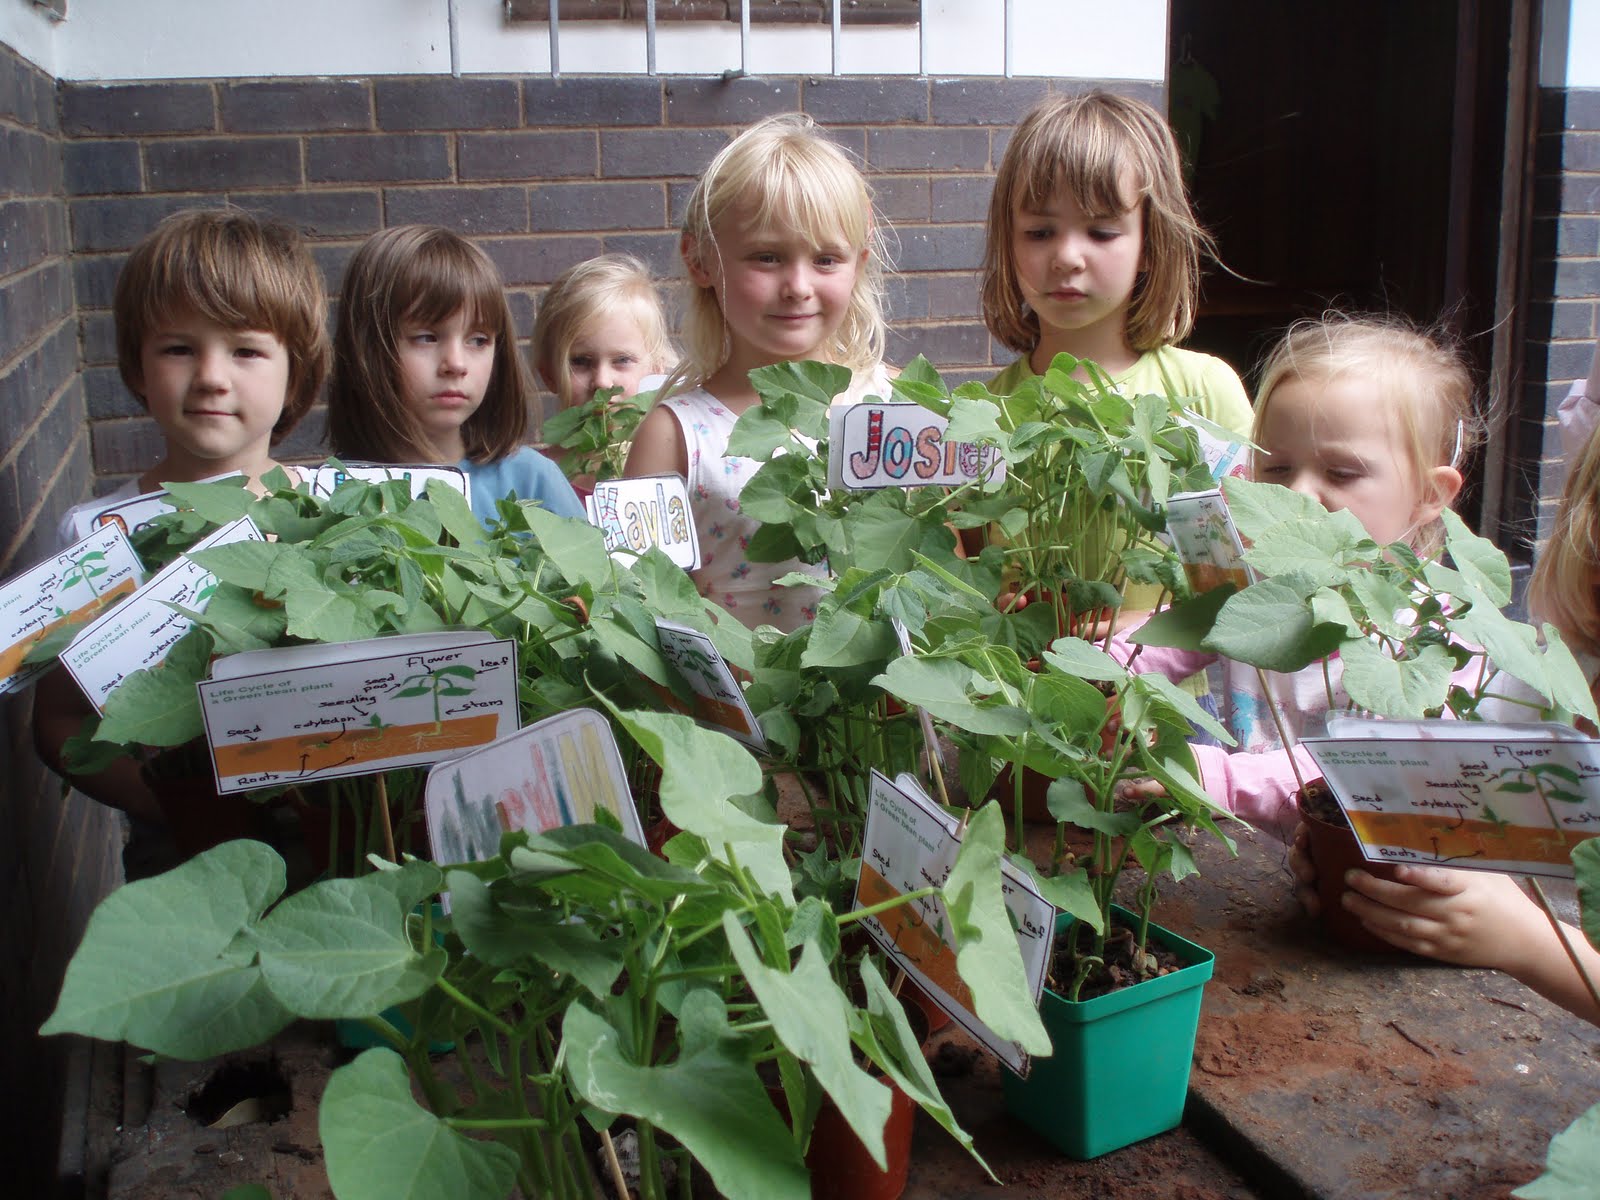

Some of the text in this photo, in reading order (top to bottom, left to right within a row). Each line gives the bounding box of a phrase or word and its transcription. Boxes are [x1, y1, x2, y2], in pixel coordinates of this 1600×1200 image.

[595, 483, 688, 551] Kayla
[3, 594, 22, 609] plant
[72, 623, 123, 664] Life Cycle of
[83, 644, 108, 663] Green
[109, 629, 131, 645] bean
[131, 611, 151, 631] plant
[480, 656, 509, 668] leaf
[364, 673, 395, 685] seed
[210, 689, 234, 698] Life
[238, 682, 274, 694] Cycle
[223, 692, 261, 703] Green
[266, 687, 297, 696] bean
[301, 682, 334, 693] plant
[363, 683, 388, 693] pod
[318, 694, 377, 708] seedling
[1341, 751, 1374, 760] Cycle
[1368, 758, 1397, 766] bean
[1400, 759, 1430, 768] plant
[1576, 760, 1600, 773] lea
[237, 772, 280, 786] Roots
[875, 788, 917, 825] Life Cycle of
[879, 802, 900, 823] Green
[901, 820, 918, 838] bean
[918, 834, 936, 854] plant
[1379, 848, 1417, 858] Roots
[1023, 913, 1045, 939] leaf
